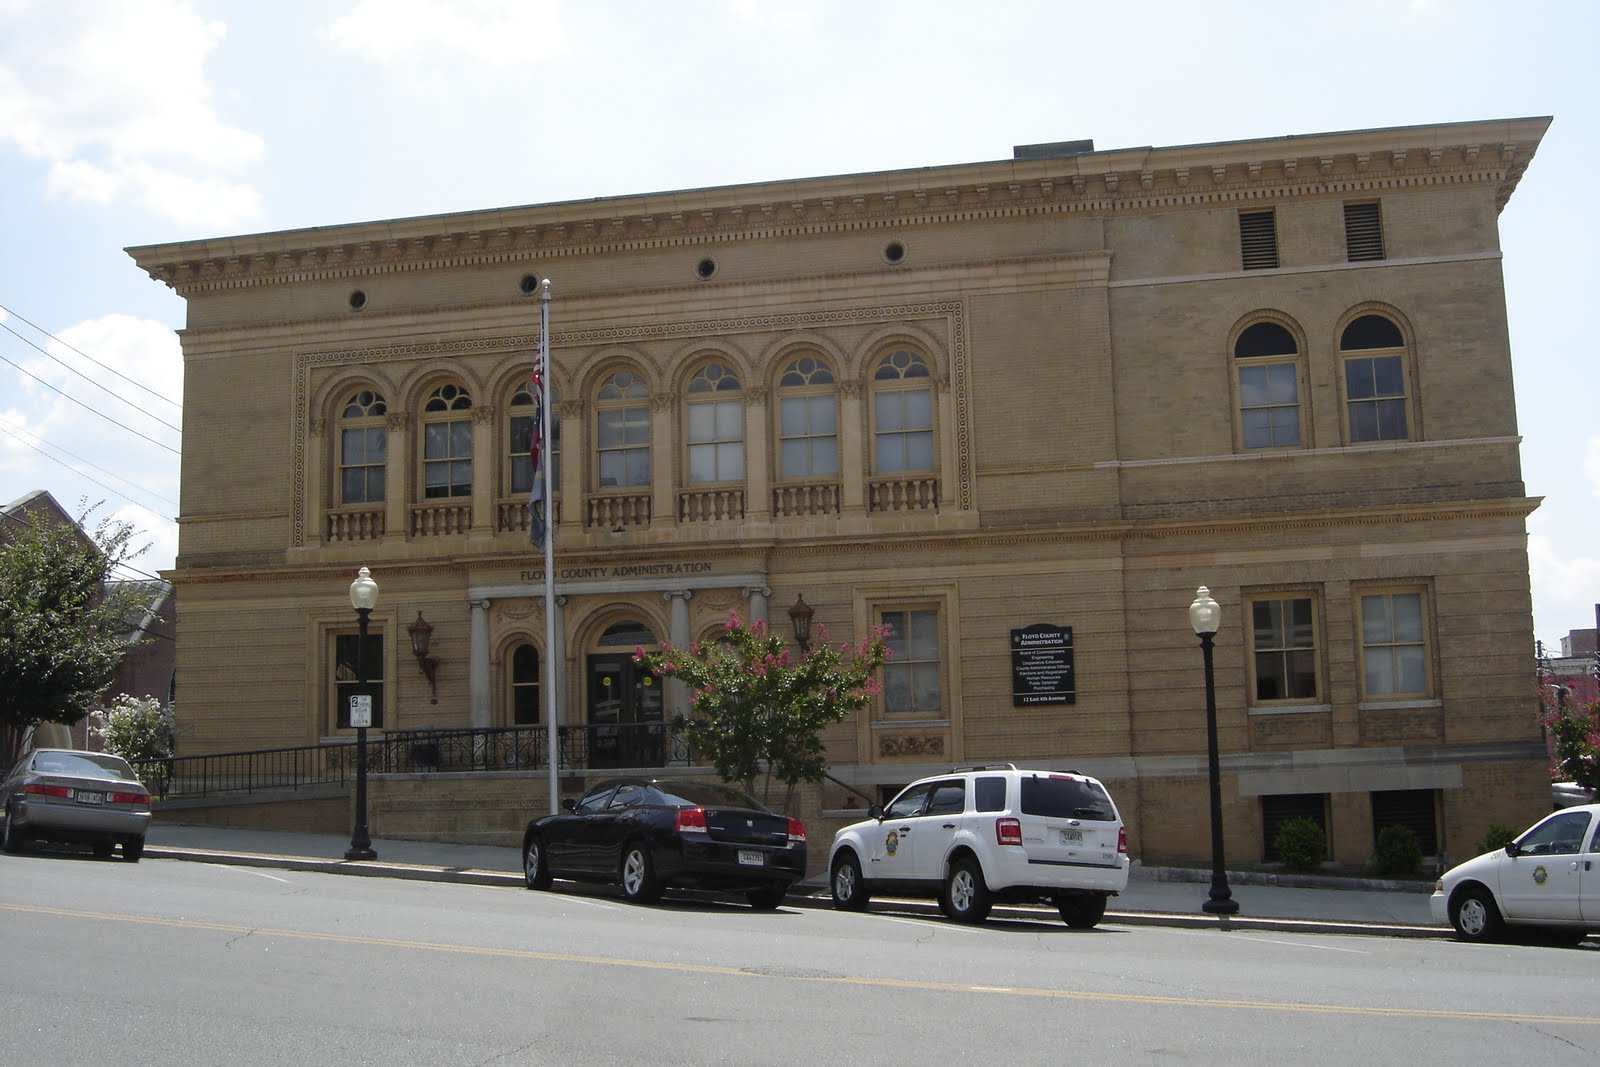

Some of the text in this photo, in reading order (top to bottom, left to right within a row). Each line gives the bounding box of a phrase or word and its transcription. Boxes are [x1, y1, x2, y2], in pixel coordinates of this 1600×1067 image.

[561, 567, 608, 579] COUNTY
[612, 562, 712, 577] ADMINISTRATION
[352, 697, 357, 706] 2
